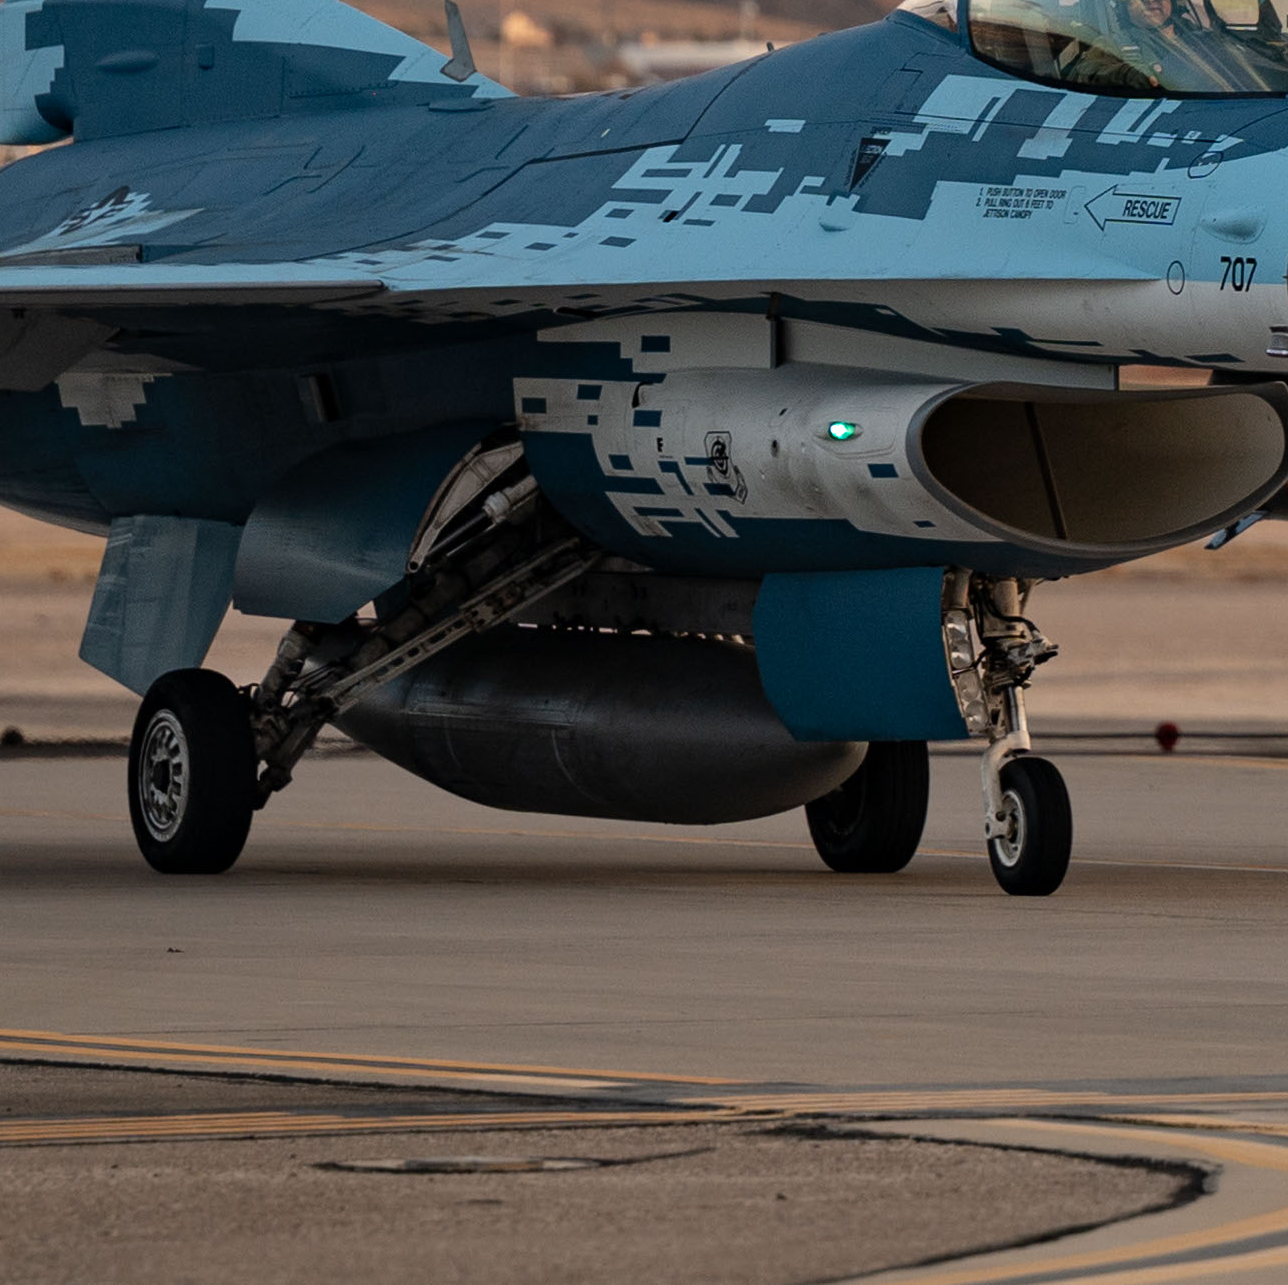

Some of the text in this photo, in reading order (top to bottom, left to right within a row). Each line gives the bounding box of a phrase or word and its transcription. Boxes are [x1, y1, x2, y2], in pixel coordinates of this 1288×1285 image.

[986, 187, 1001, 196] PUSH
[1002, 188, 1024, 197] BUTTON
[1025, 188, 1033, 197] TO
[1033, 189, 1049, 198] OPEN
[1049, 189, 1067, 199] DOOR
[984, 198, 998, 207] PULL
[999, 198, 1012, 208] RING
[1013, 199, 1025, 208] OUT
[1031, 199, 1045, 209] FEET
[1045, 200, 1054, 210] TO
[1122, 199, 1172, 219] RESCUE
[983, 208, 1033, 219] JETTISON CANOPY
[1220, 256, 1257, 292] 707
